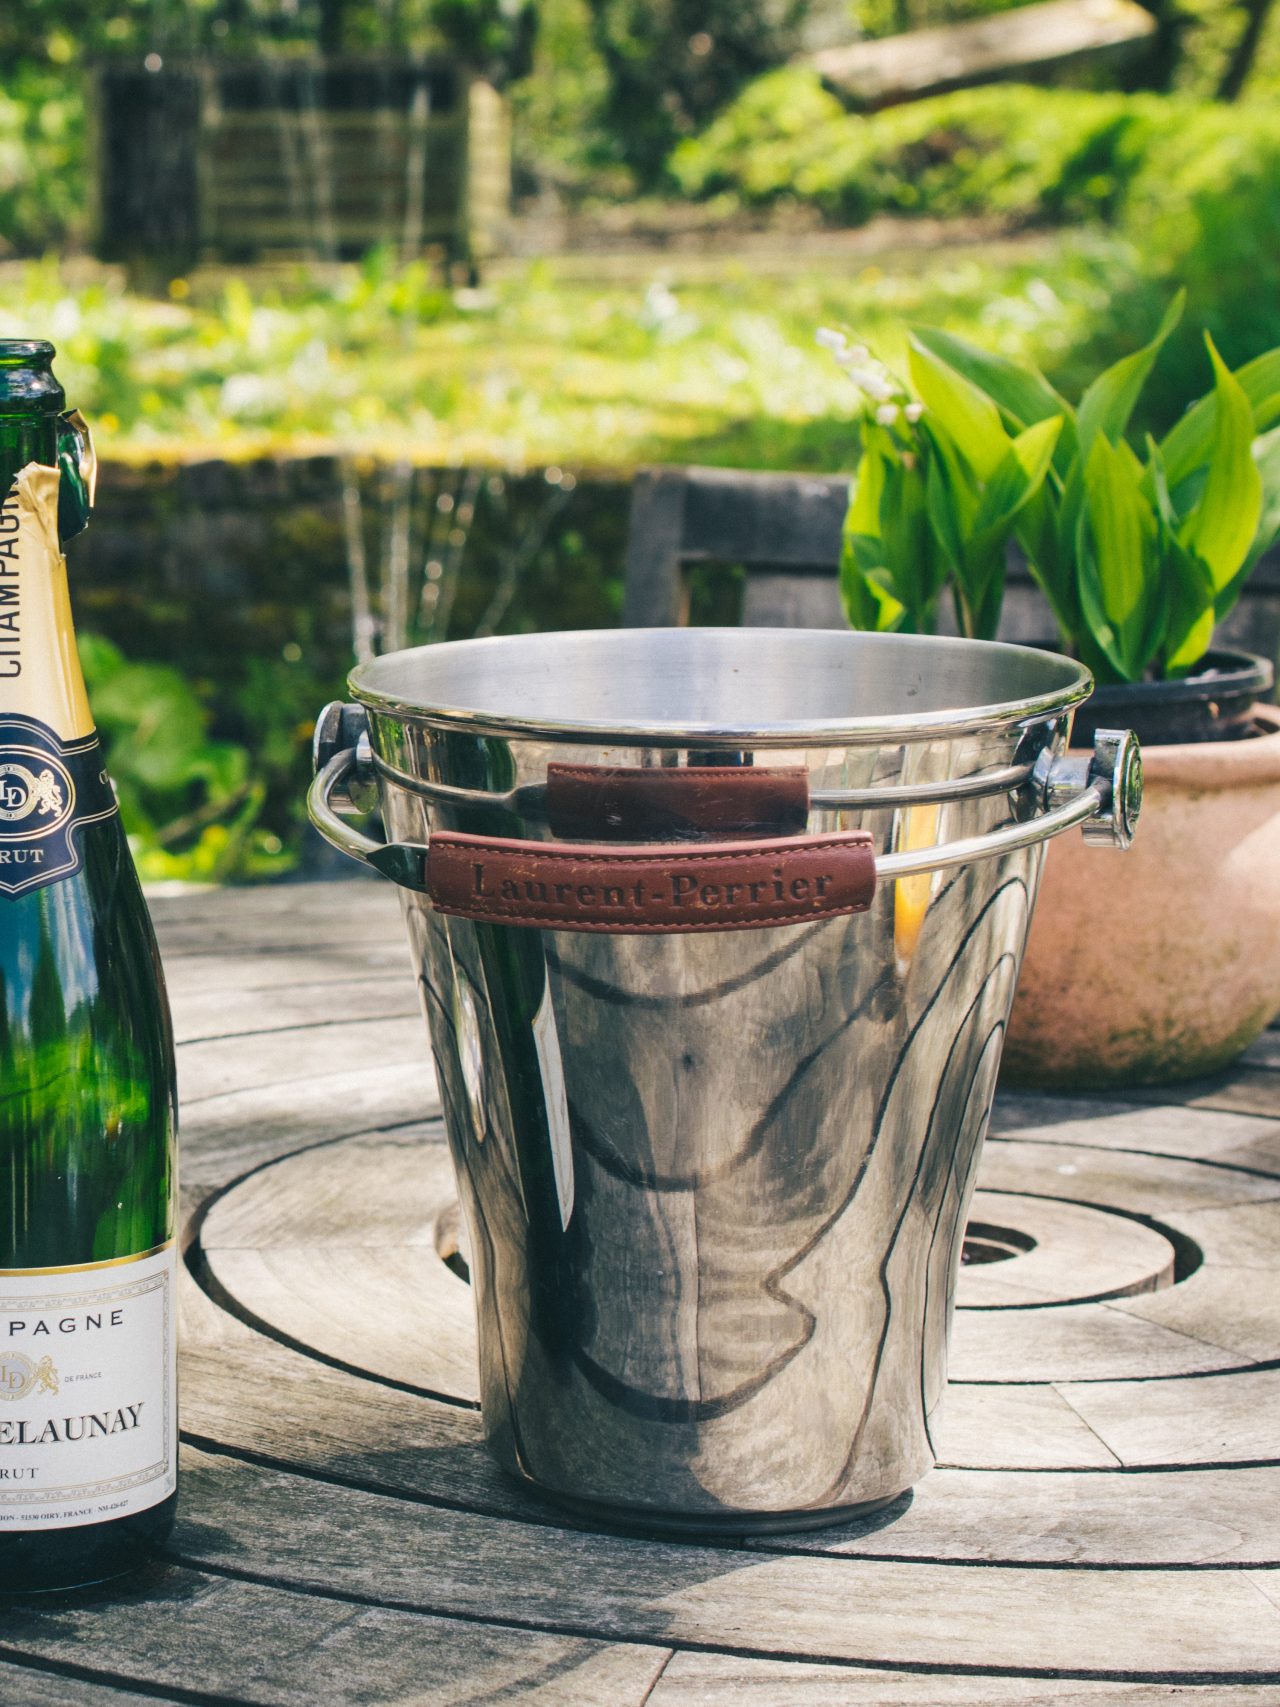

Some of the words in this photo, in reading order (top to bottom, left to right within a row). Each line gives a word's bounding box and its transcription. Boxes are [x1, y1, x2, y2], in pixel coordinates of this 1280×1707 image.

[472, 863, 834, 908] Laurent-Perrier
[64, 1375, 75, 1383] DE
[75, 1371, 103, 1382] FRANCE
[63, 1507, 92, 1518] FRANCE
